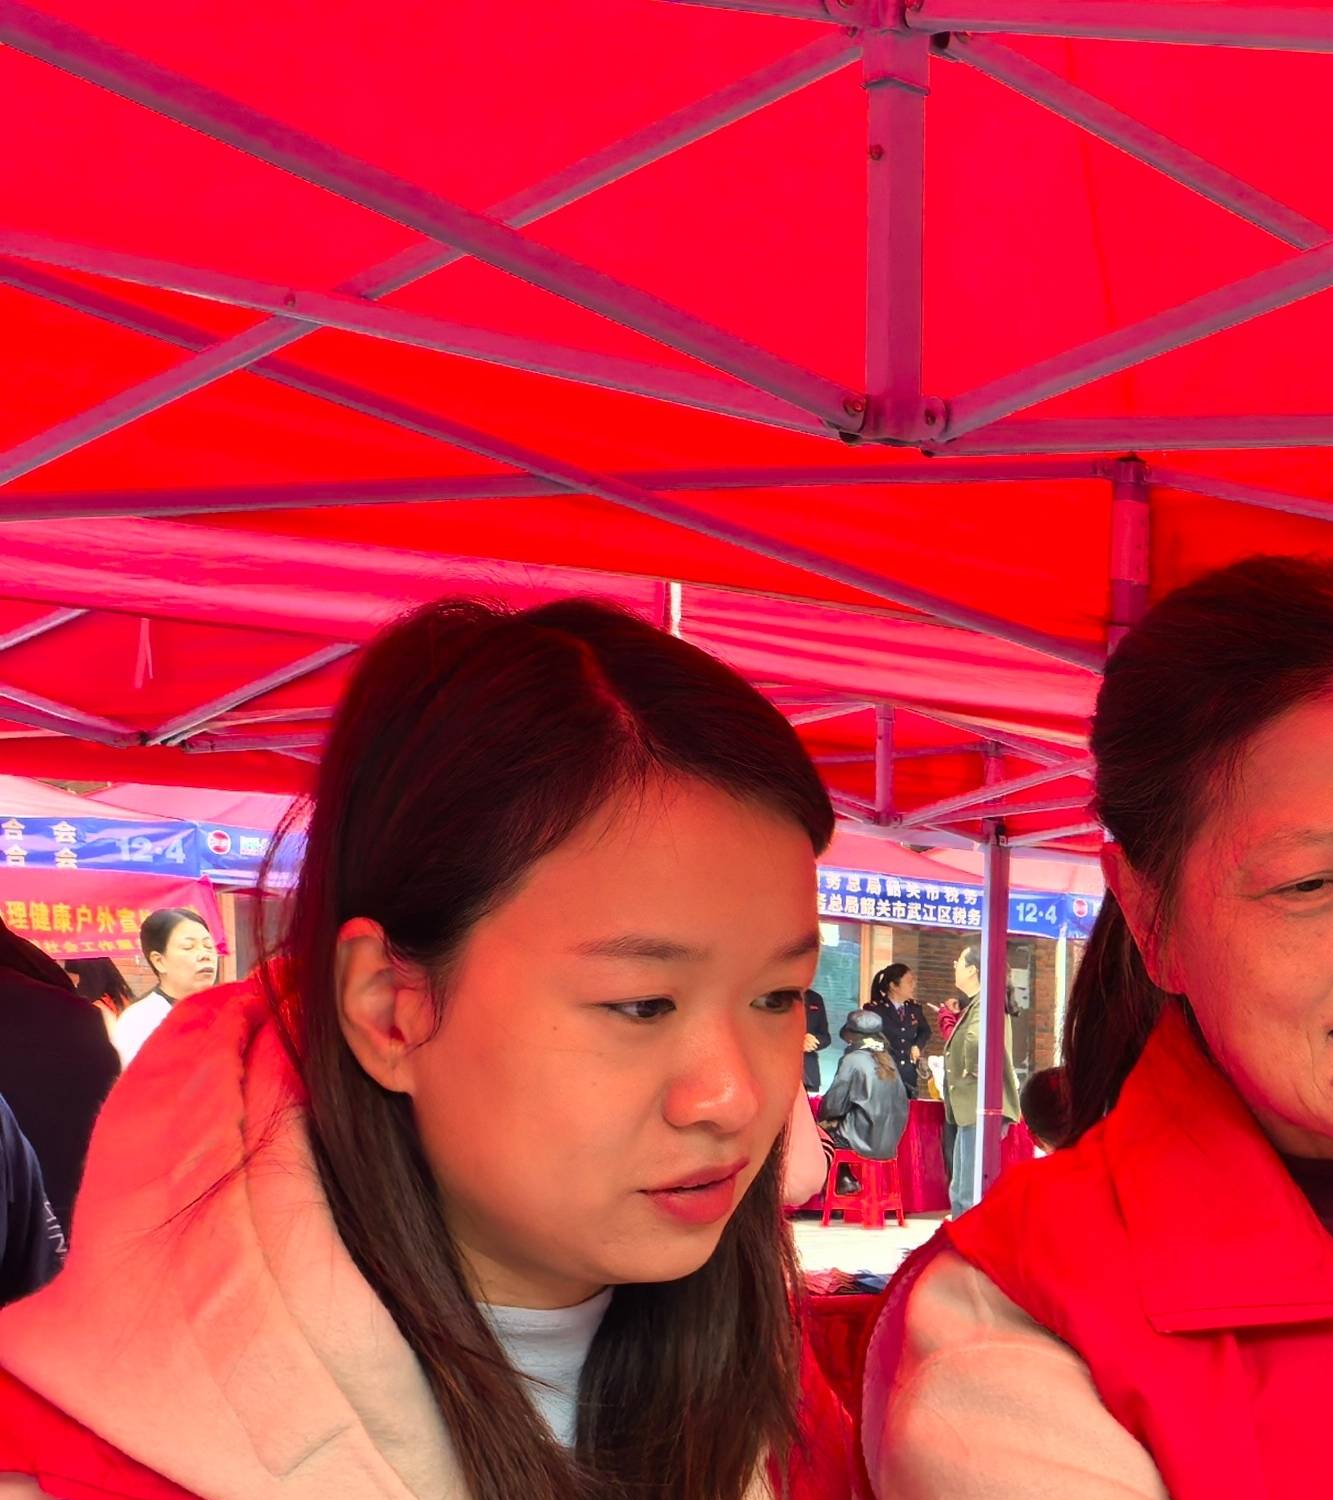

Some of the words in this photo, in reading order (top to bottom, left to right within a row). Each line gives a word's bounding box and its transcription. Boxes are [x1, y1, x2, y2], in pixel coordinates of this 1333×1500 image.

[817, 871, 979, 906] 务总局韶关市税务
[1016, 902, 1057, 925] 12·4
